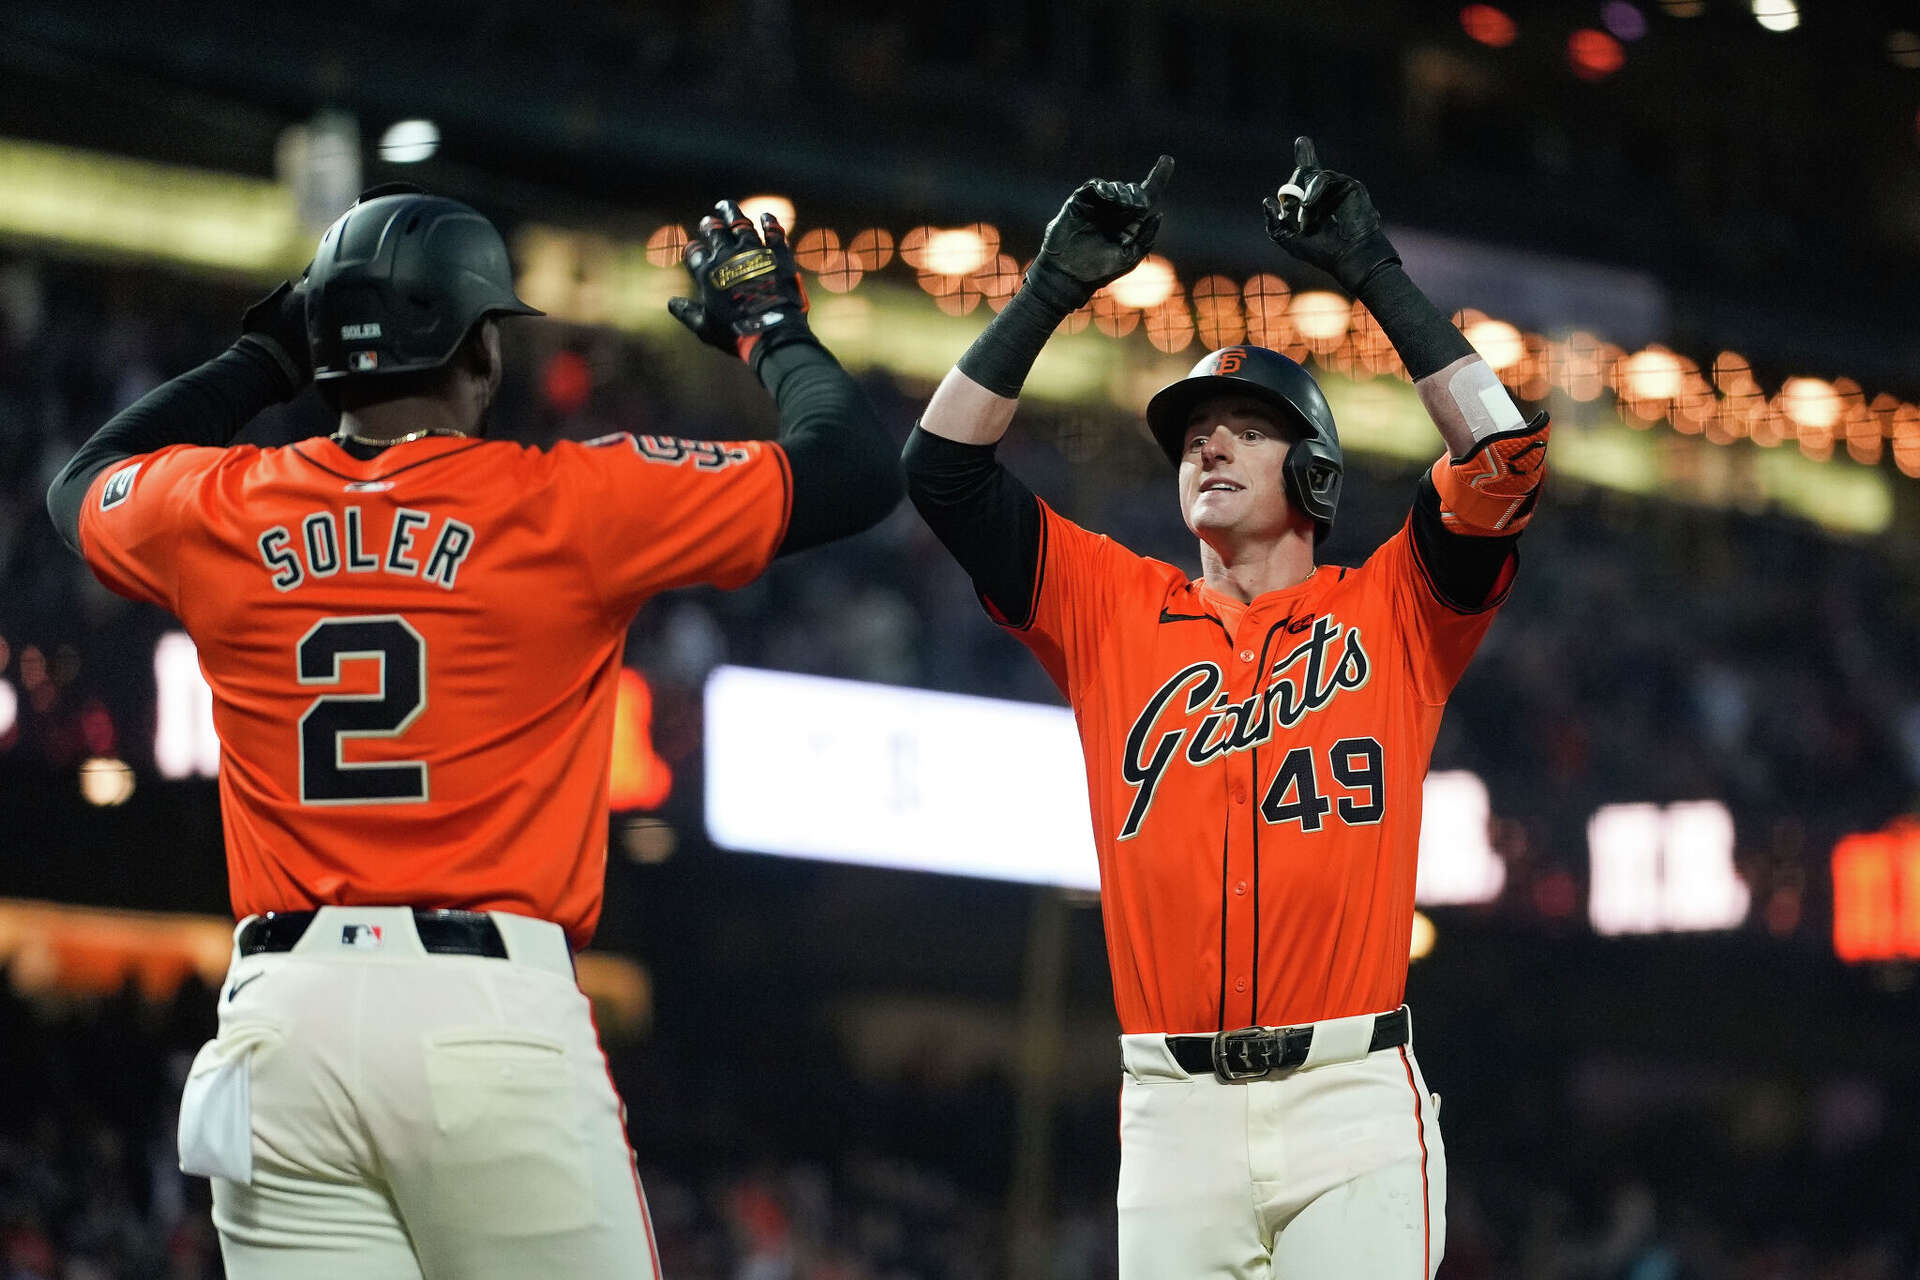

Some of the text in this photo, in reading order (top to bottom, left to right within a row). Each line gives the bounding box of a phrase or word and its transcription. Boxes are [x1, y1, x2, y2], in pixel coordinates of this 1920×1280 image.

[341, 323, 381, 340] SOLER
[257, 506, 475, 592] SOLER
[296, 614, 429, 806] 2
[1117, 613, 1371, 841] Giants
[1260, 736, 1386, 833] 49
